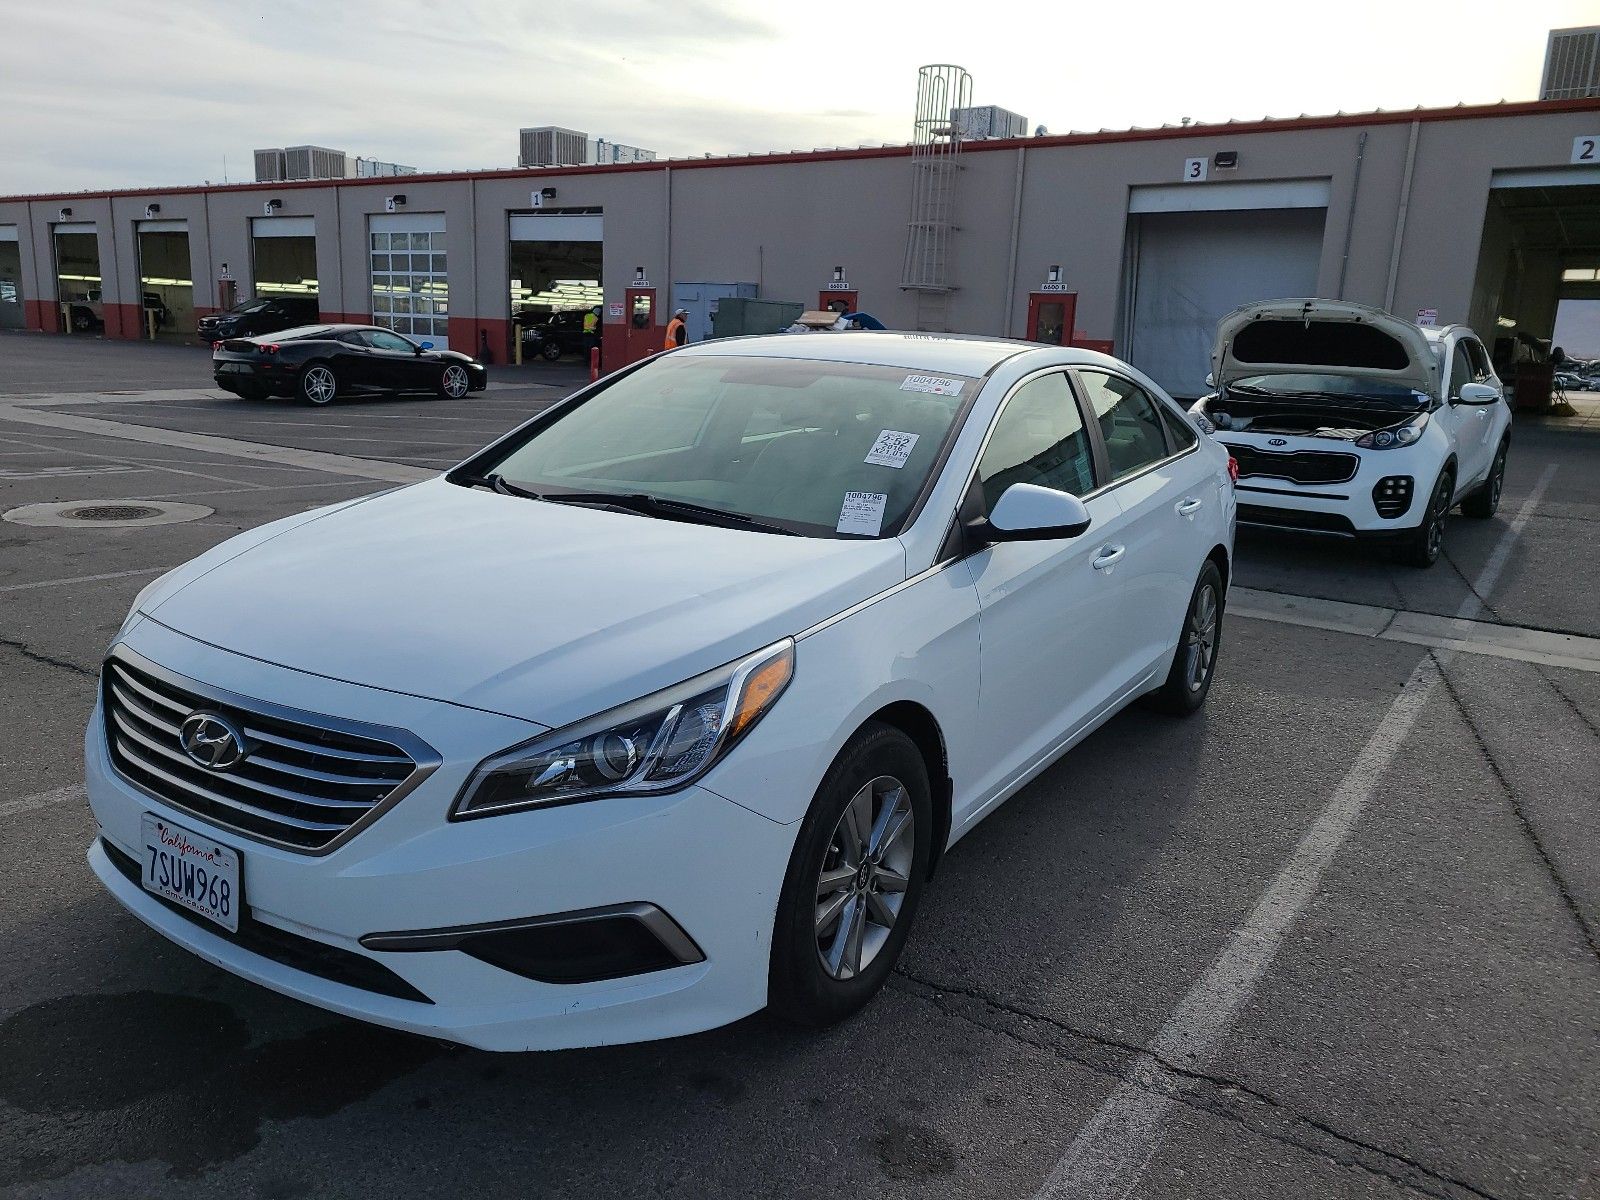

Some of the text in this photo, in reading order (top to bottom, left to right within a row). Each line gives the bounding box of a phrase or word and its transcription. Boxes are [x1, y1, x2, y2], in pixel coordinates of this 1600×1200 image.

[1580, 140, 1595, 159] 2
[1190, 161, 1202, 178] 3
[534, 194, 540, 206] 1
[908, 376, 952, 386] 1004796
[847, 492, 883, 501] 1004796
[160, 827, 220, 867] California
[146, 844, 231, 917] 7SUW968
